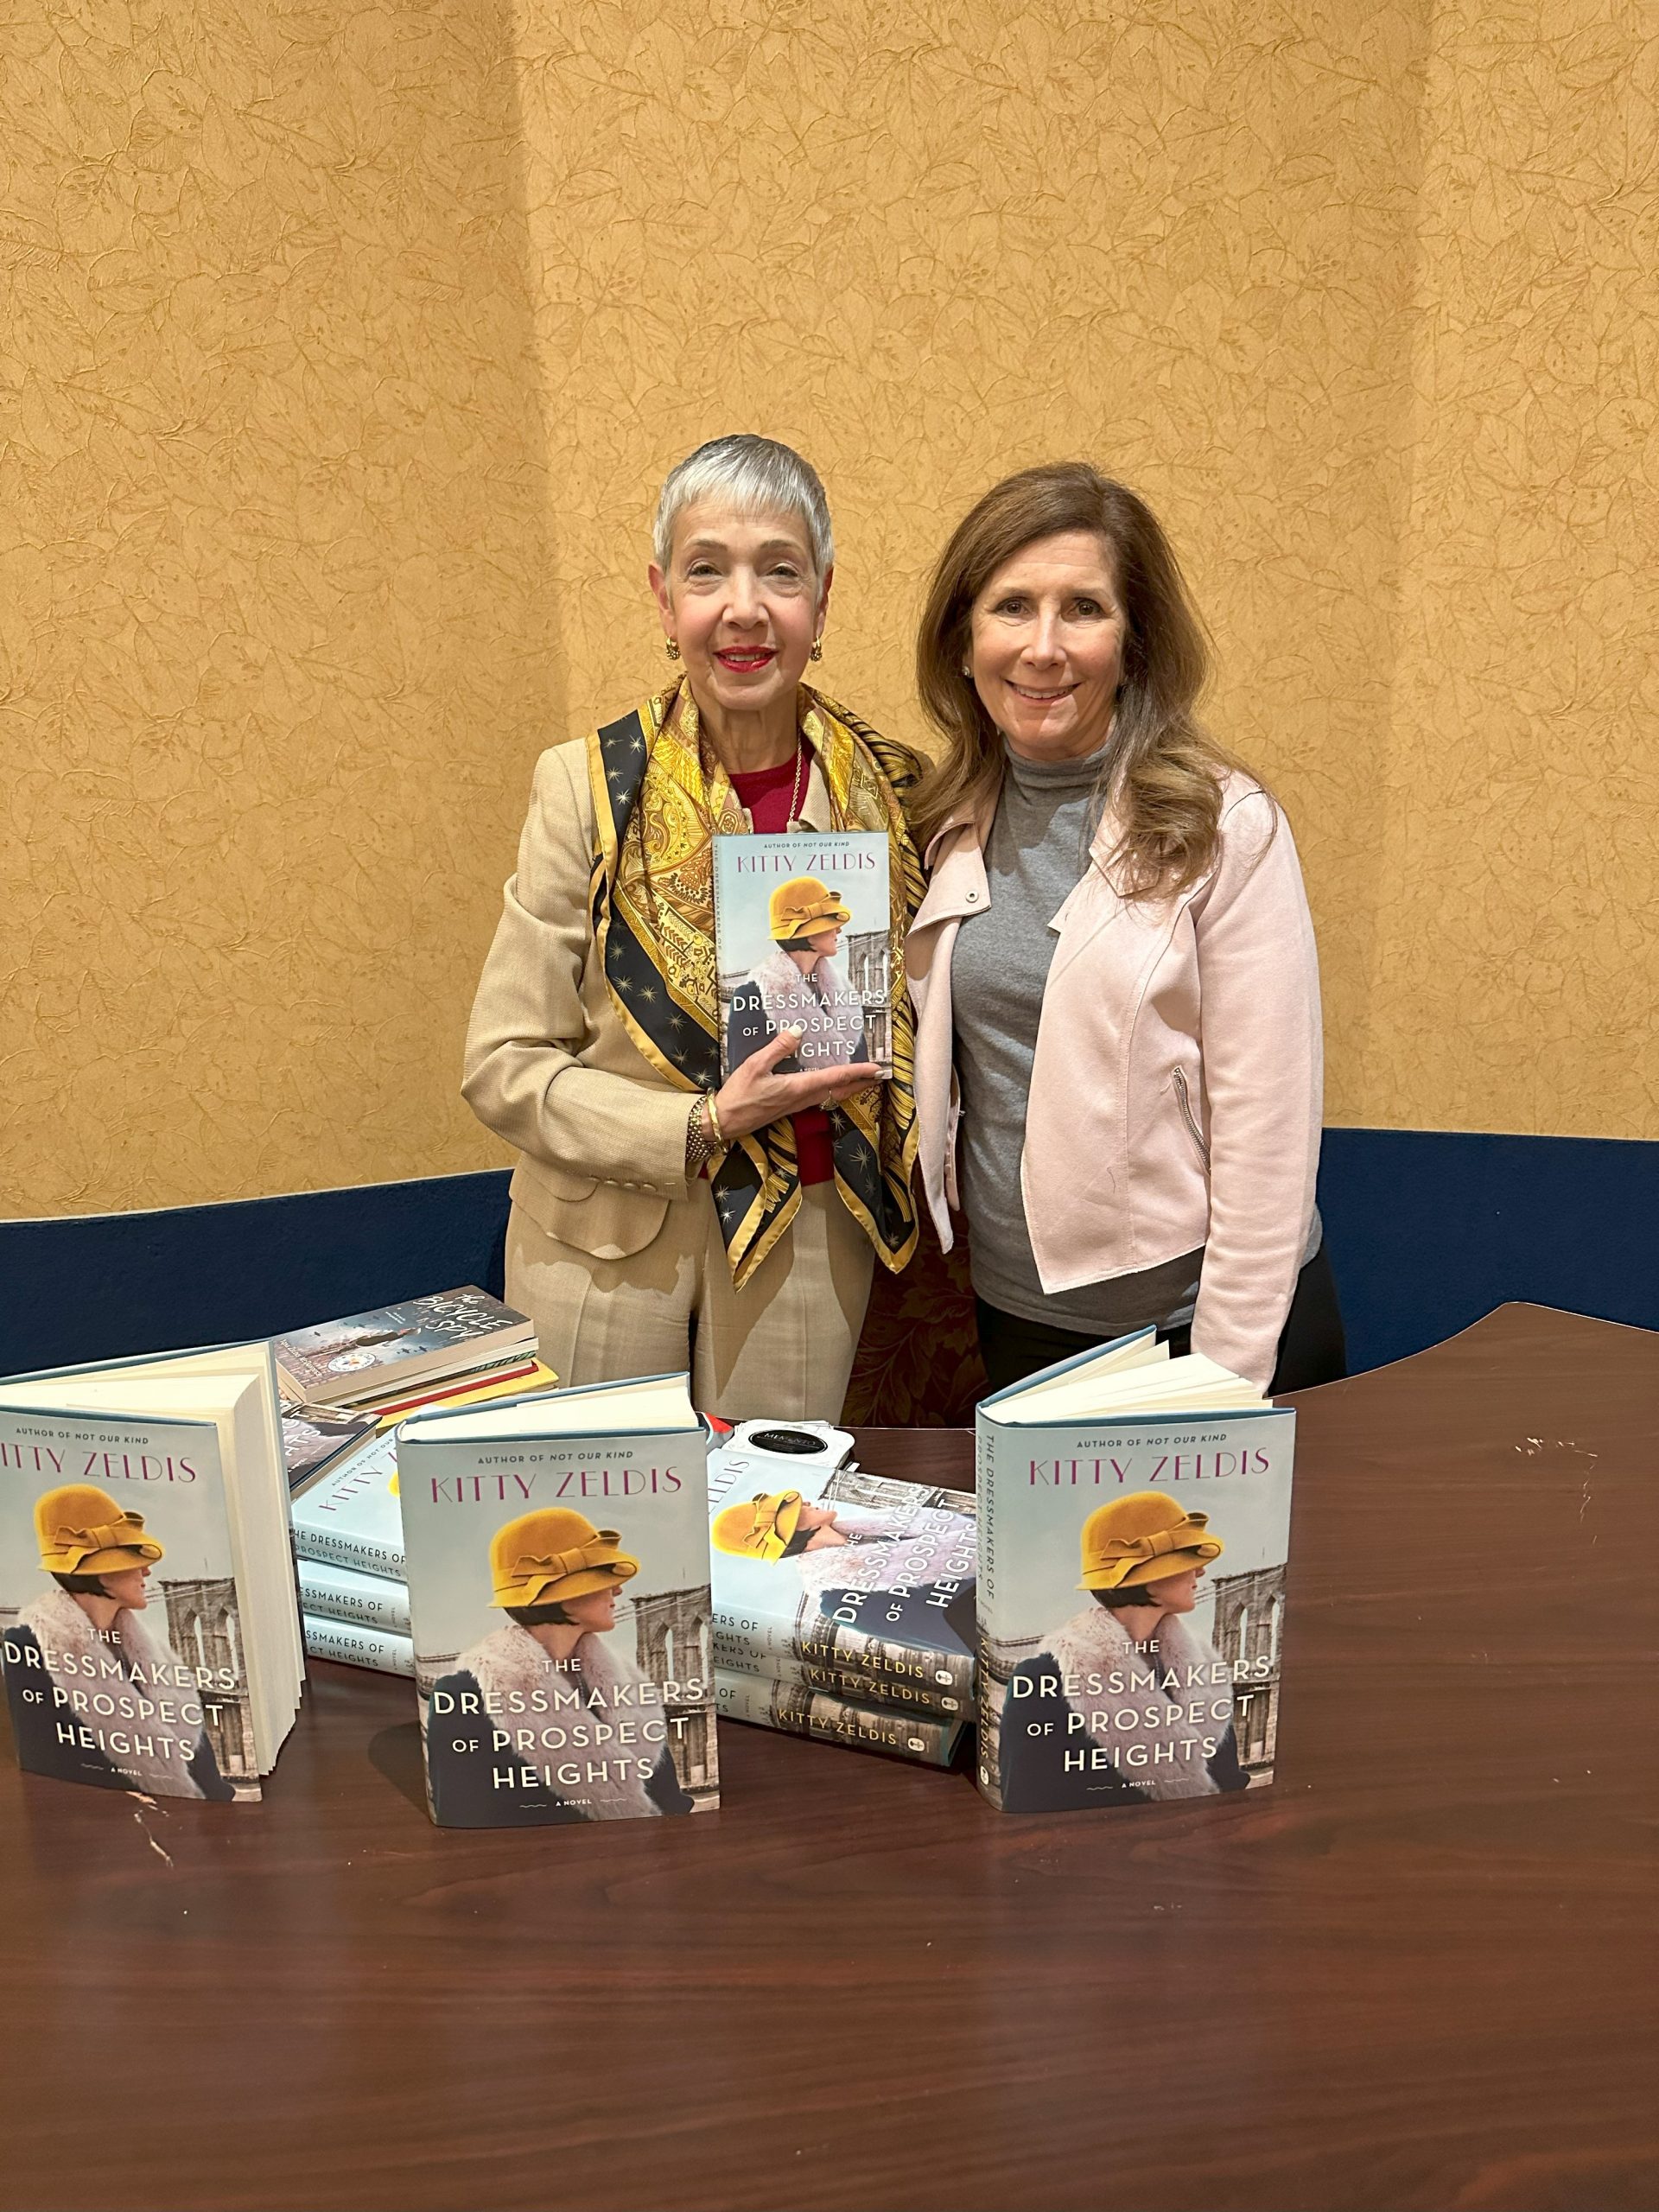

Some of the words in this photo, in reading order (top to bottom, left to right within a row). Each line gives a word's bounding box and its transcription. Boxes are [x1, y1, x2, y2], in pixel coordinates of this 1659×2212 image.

[737, 855, 796, 873] KITTY
[806, 852, 875, 871] ZELDIS
[796, 973, 818, 982] THE
[733, 988, 885, 1012] DRESSMAKERS
[742, 1027, 759, 1036] OF
[766, 1014, 876, 1035] PROSPECT
[783, 1040, 855, 1059] GHTS
[412, 1295, 513, 1330] BICYCLE
[424, 1320, 484, 1339] SPY
[16, 1427, 54, 1438] AUTHOR
[124, 1436, 149, 1445] KIND
[1077, 1440, 1122, 1448] AUTHOR
[1147, 1437, 1169, 1446] NOT
[1200, 1433, 1227, 1442] KIND
[0, 1442, 66, 1473] ITTY
[82, 1451, 196, 1484] ZELDIS
[332, 1467, 356, 1486] AUTHOR
[367, 1448, 379, 1459] NOT
[380, 1438, 393, 1448] OUR
[478, 1454, 524, 1465] AUTHOR
[530, 1453, 544, 1462] OF
[550, 1452, 573, 1461] NOT
[577, 1452, 601, 1460] OUR
[1030, 1458, 1133, 1485] KITTY
[1149, 1446, 1269, 1483] ZELDIS
[318, 1465, 383, 1511] KITTY
[431, 1473, 537, 1503] KITTY
[556, 1465, 682, 1497] ZELDIS
[708, 1461, 749, 1503] ELDIS
[293, 1529, 306, 1540] HE
[310, 1533, 387, 1560] DRESSMAKERS
[391, 1553, 406, 1564] OF
[832, 1485, 930, 1624] DRESSMAKERS
[839, 1533, 862, 1553] THE
[888, 1498, 960, 1598] PROSPECT
[353, 1560, 401, 1577] HEIGHTS
[299, 1586, 363, 1608] ESSMAKERS
[367, 1601, 383, 1611] OF
[987, 1579, 994, 1599] OF
[327, 1606, 378, 1624] HEIGHTS
[741, 1619, 759, 1630] OF
[886, 1603, 903, 1622] OF
[86, 1627, 122, 1644] THE
[305, 1630, 364, 1650] SSMAKERS
[369, 1643, 385, 1654] OF
[715, 1631, 750, 1645] GHTS
[1122, 1640, 1160, 1655] THE
[4, 1641, 235, 1690] DRESSMAKERS
[328, 1650, 378, 1667] HEIGHTS
[542, 1658, 582, 1673] THE
[714, 1656, 760, 1673] EIGHTS
[801, 1641, 853, 1662] KITTY
[861, 1654, 924, 1679] ZELDIS
[980, 1637, 989, 1693] KITTY
[810, 1669, 861, 1688] KITTY
[868, 1681, 930, 1705] ZELDIS
[1012, 1655, 1270, 1699] DRESSMAKERS
[22, 1689, 44, 1704] OF
[52, 1686, 224, 1726] PROSPECT
[433, 1677, 703, 1715] DRESSMAKERS
[719, 1688, 736, 1699] OF
[779, 1708, 829, 1729] KITTY
[836, 1721, 896, 1745] ZELDIS
[980, 1694, 989, 1759] ZELDIS
[1027, 1722, 1054, 1737] OF
[1067, 1694, 1255, 1734] PROSPECT
[55, 1721, 196, 1762] HEIGHTS
[452, 1739, 479, 1753] OF
[493, 1717, 690, 1751] PROSPECT
[1064, 1736, 1217, 1772] HEIGHTS
[118, 1767, 142, 1777] NOVEL
[493, 1758, 654, 1789] HEIGHTS
